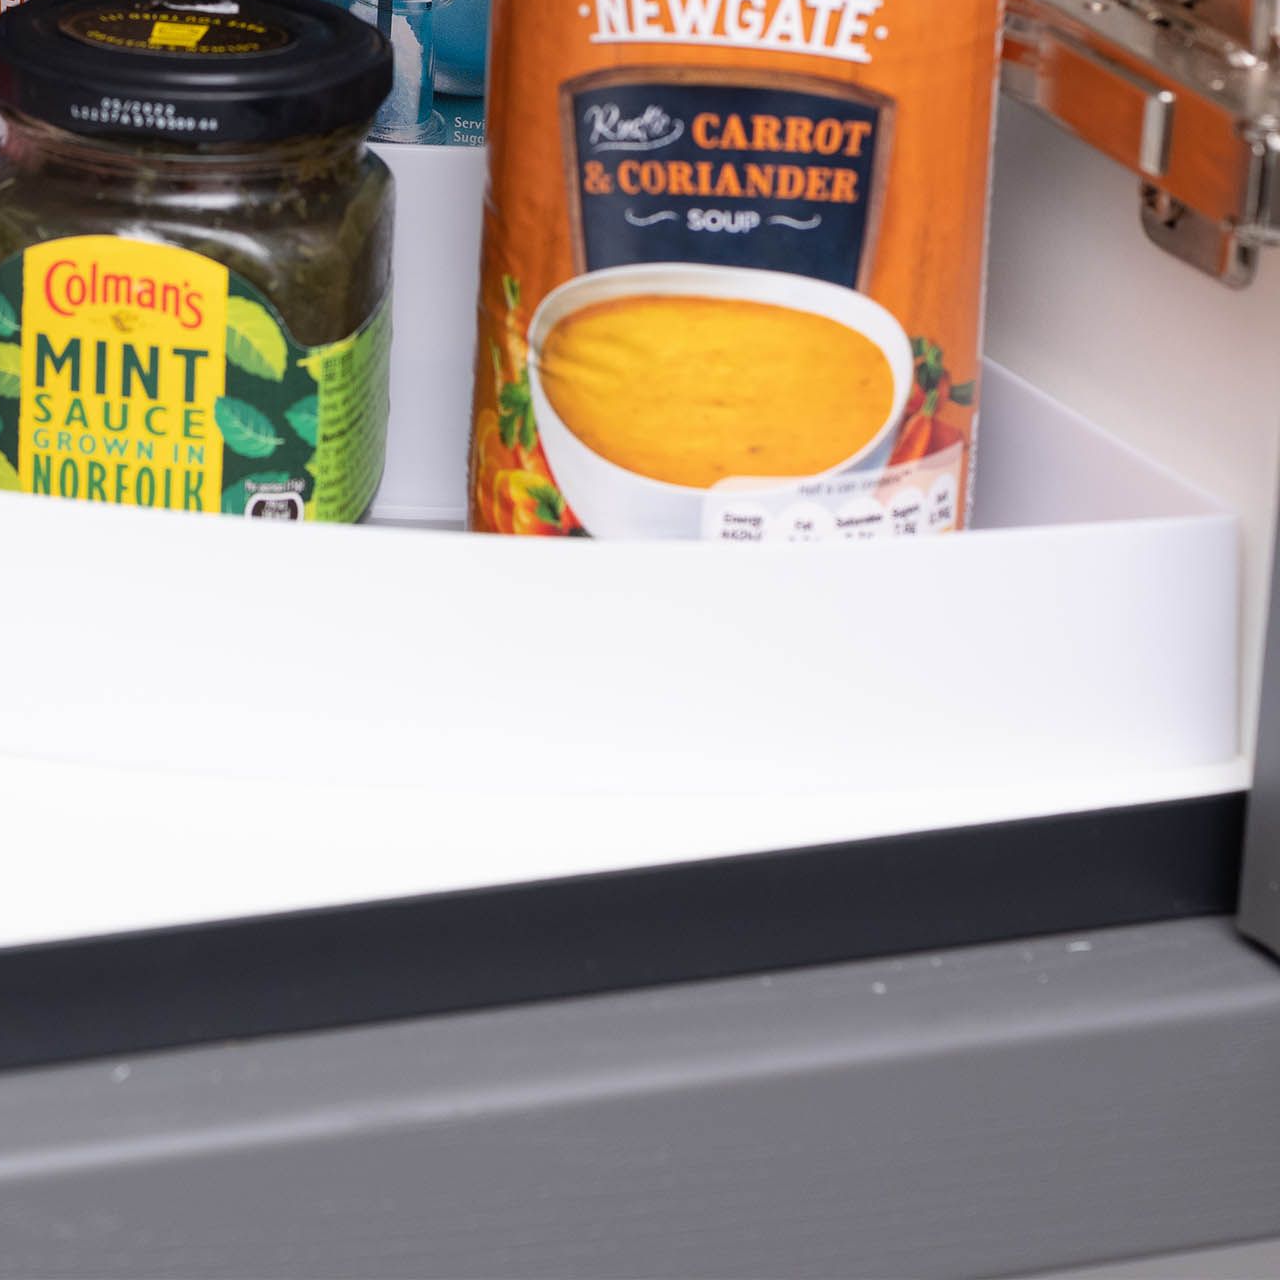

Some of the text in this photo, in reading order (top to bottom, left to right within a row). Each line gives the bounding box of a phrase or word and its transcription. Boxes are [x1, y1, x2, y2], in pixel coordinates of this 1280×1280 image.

[692, 111, 871, 157] CARROT
[583, 160, 859, 203] & CORIANDER
[686, 208, 760, 233] SOUP
[44, 259, 204, 329] Colman's
[35, 333, 209, 404] MINT
[33, 393, 206, 439] SAUCE
[33, 429, 205, 465] GROWN IN
